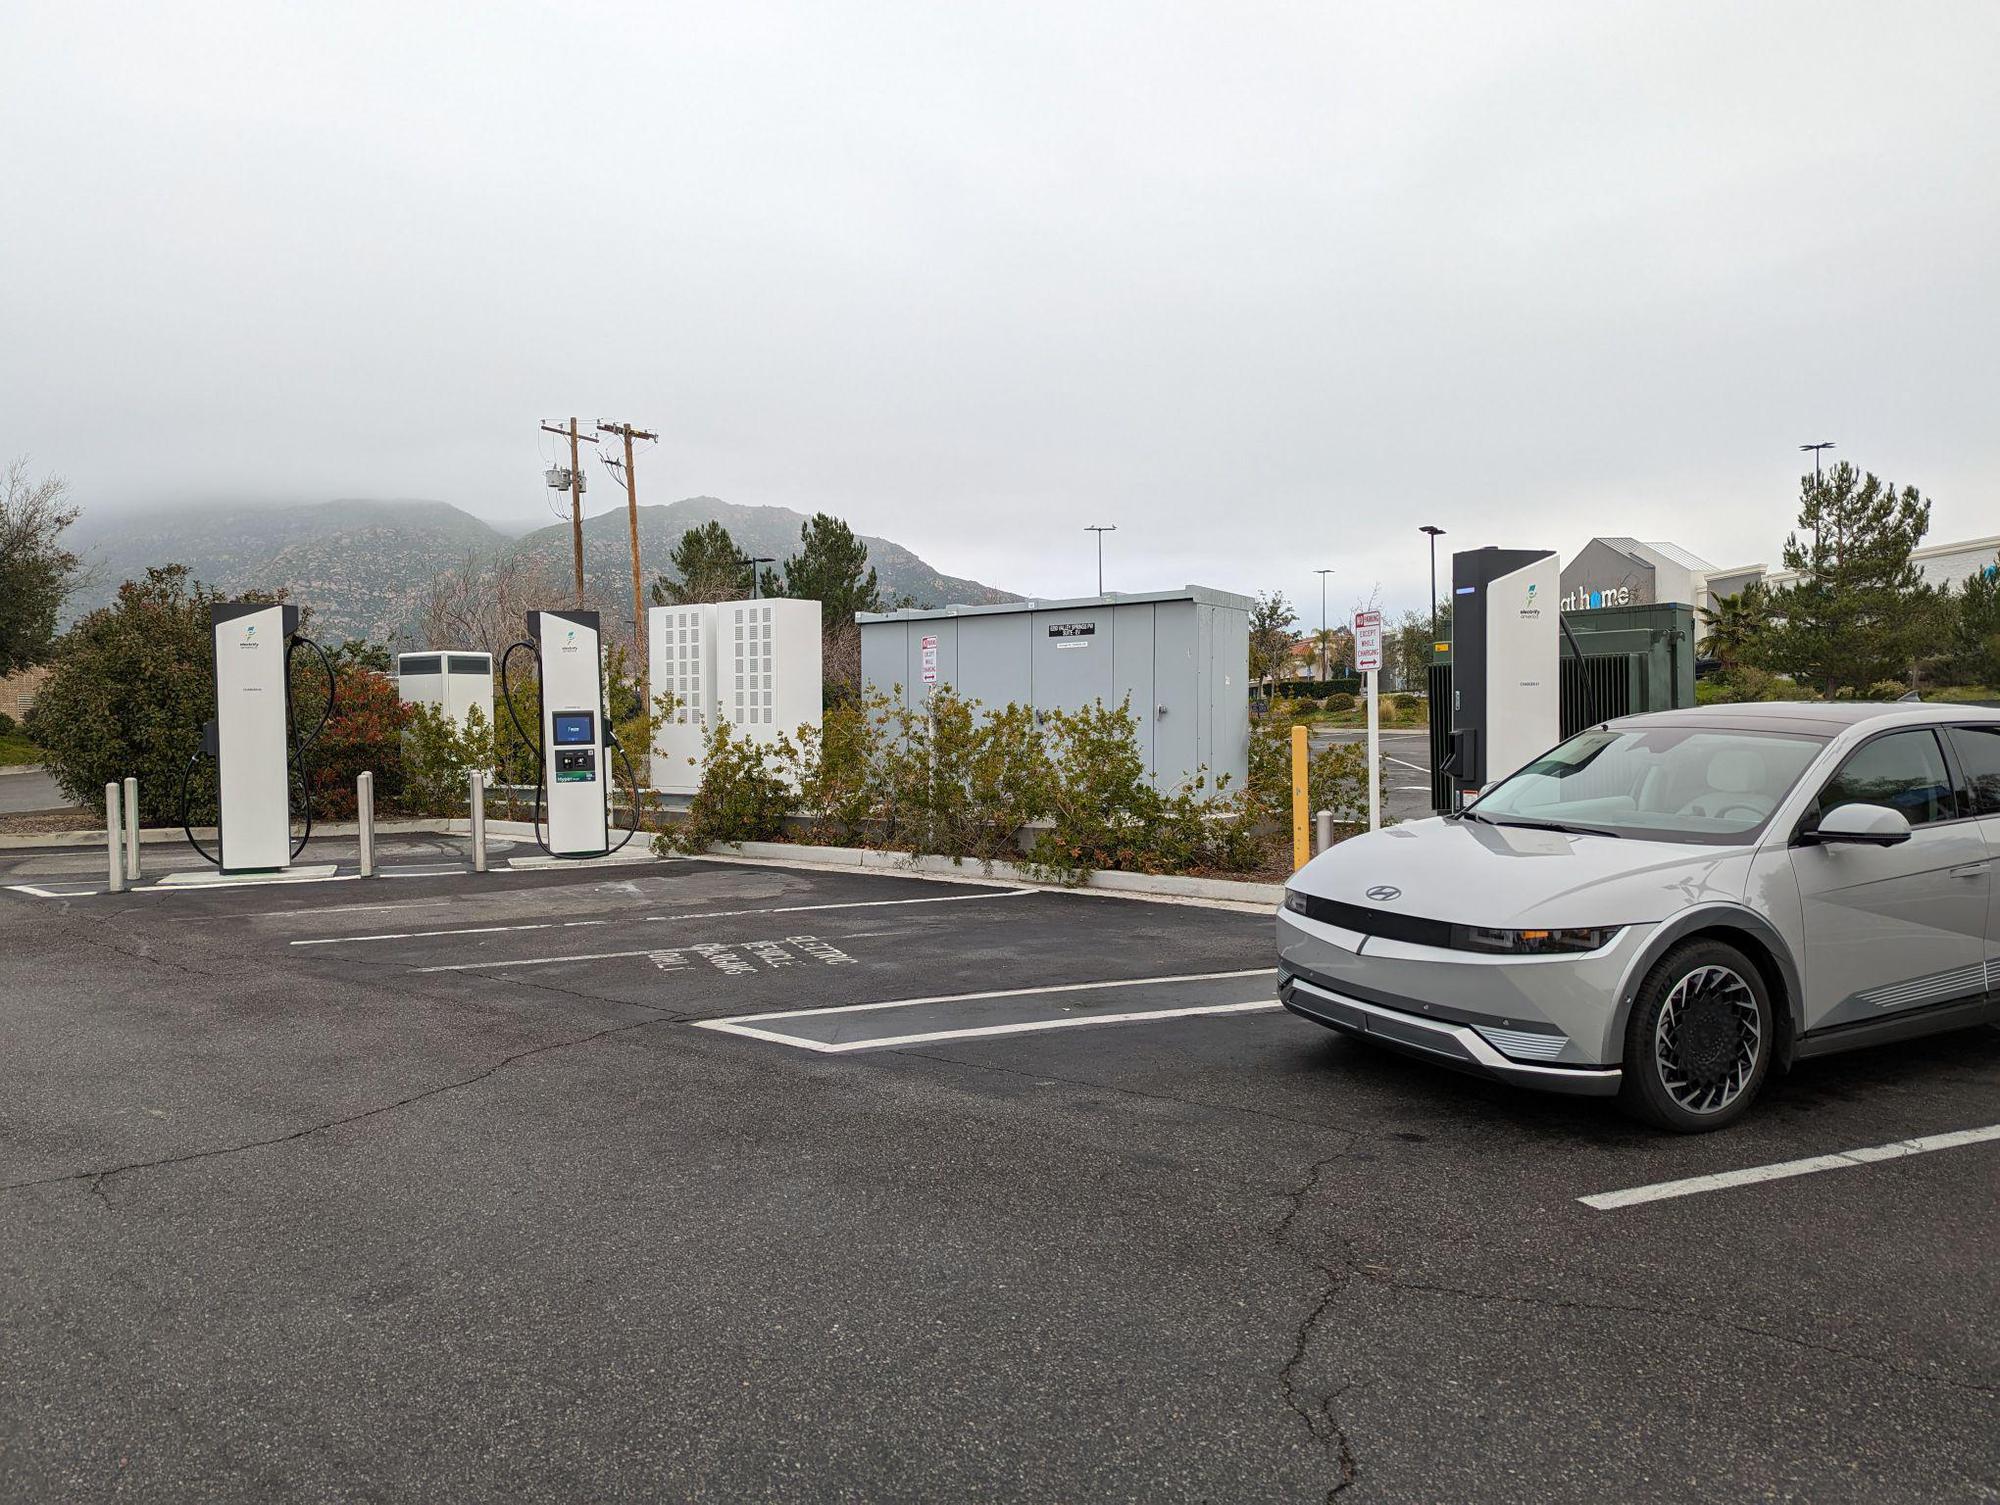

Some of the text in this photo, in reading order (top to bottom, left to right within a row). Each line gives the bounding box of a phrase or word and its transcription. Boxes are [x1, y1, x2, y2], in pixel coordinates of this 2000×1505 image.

[1561, 586, 1629, 611] at home
[1364, 613, 1379, 622] PARKING
[1360, 629, 1376, 638] EXCEPT
[1361, 639, 1375, 647] WHILE
[1358, 649, 1379, 657] CHARGING
[741, 940, 807, 968] VEHICLE
[786, 935, 859, 965] ELECTRIC
[692, 943, 758, 975] CHARGING
